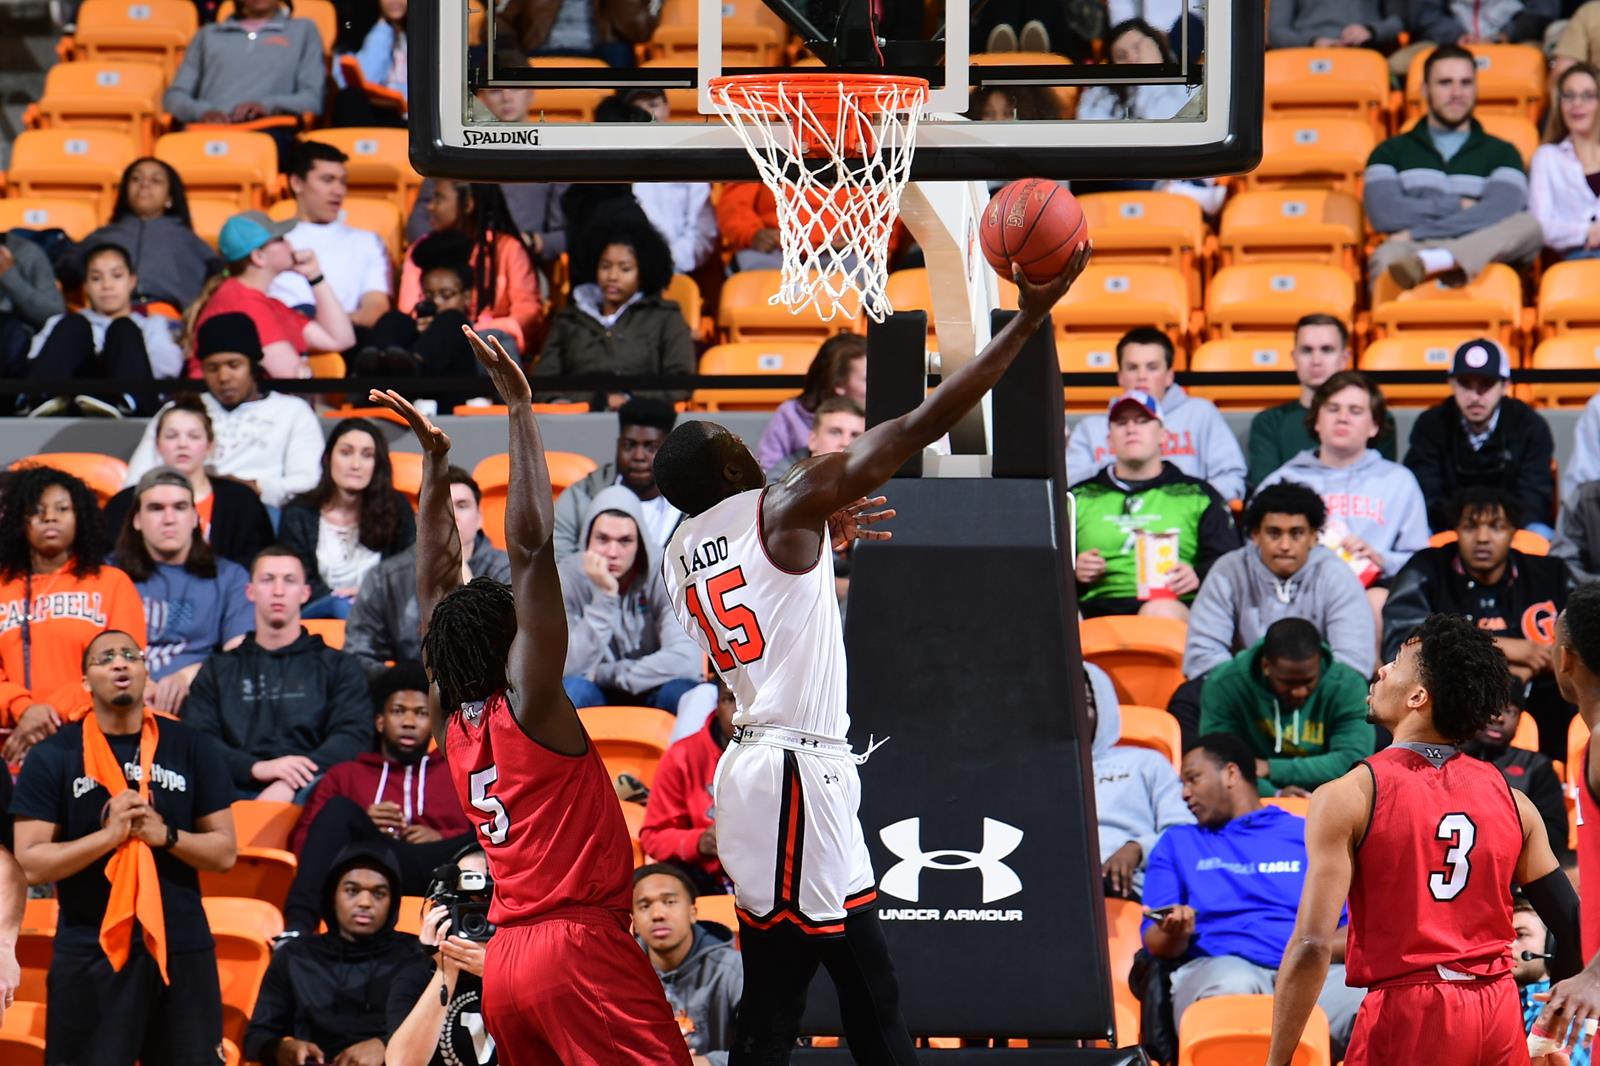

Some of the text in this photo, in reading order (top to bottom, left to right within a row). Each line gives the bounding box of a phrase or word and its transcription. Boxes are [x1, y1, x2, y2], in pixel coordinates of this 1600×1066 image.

[463, 129, 538, 146] SPALDING
[680, 536, 728, 578] LADO
[685, 564, 766, 673] 15
[124, 761, 143, 781] Ge
[151, 763, 187, 792] Hype
[468, 763, 511, 846] 5
[1258, 860, 1300, 873] EAGLE
[1427, 811, 1478, 901] 3
[879, 909, 1023, 921] UNDER ARMOUR
